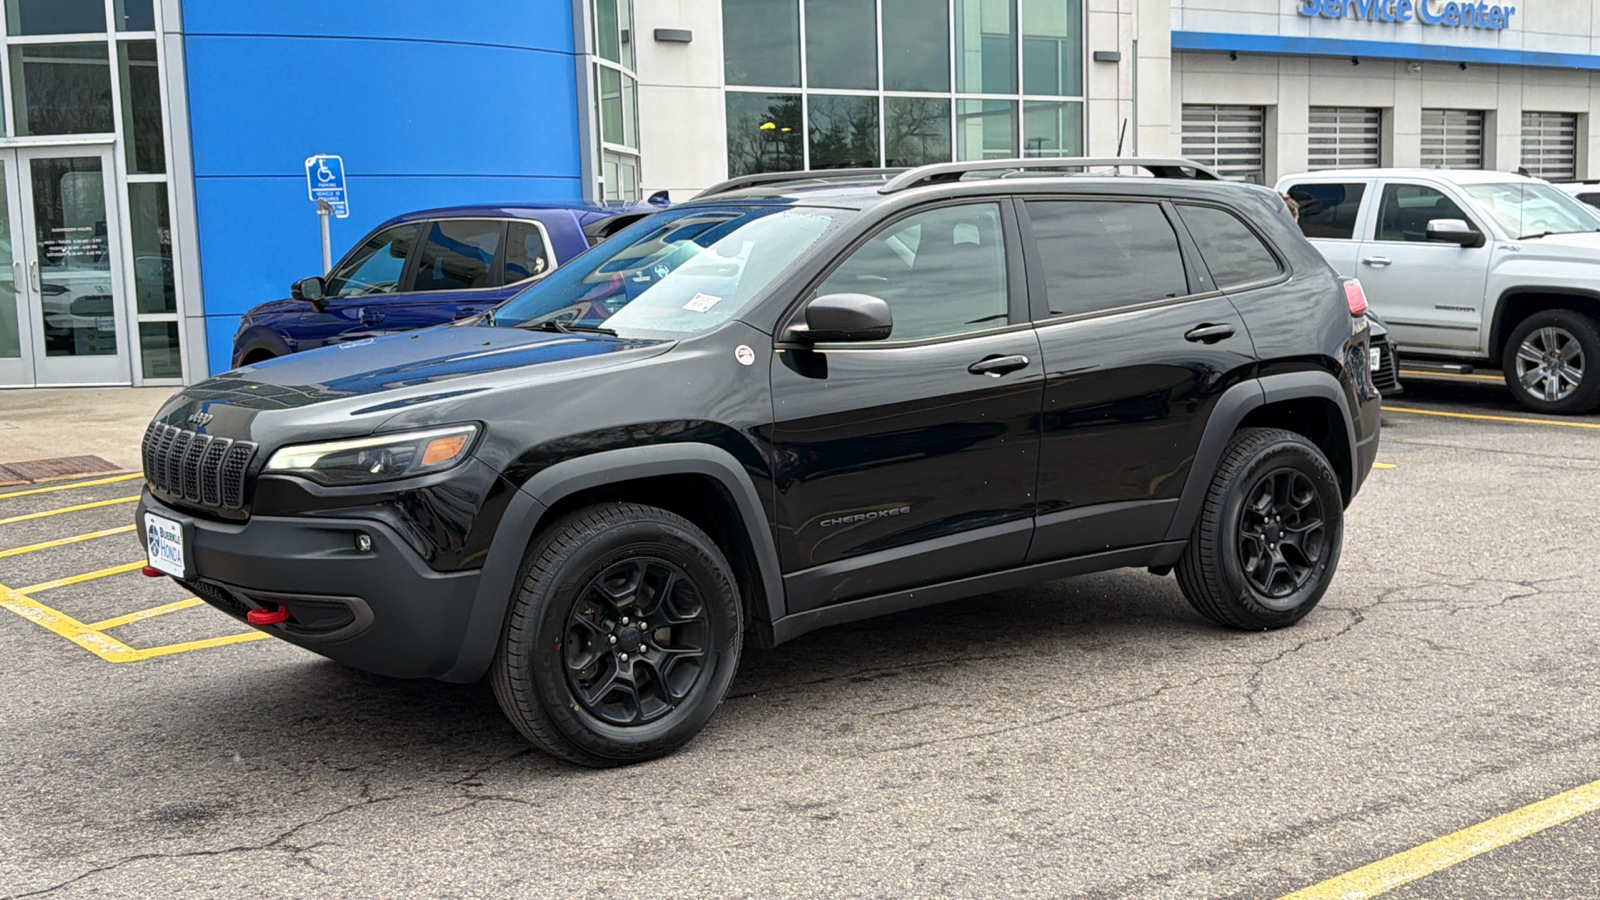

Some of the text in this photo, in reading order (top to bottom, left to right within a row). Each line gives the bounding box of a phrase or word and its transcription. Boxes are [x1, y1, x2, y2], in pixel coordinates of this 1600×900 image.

[1418, 0, 1516, 29] Center
[820, 506, 911, 527] CHEROKEE
[159, 526, 181, 545] BUERKLE
[160, 538, 183, 565] HONDA
